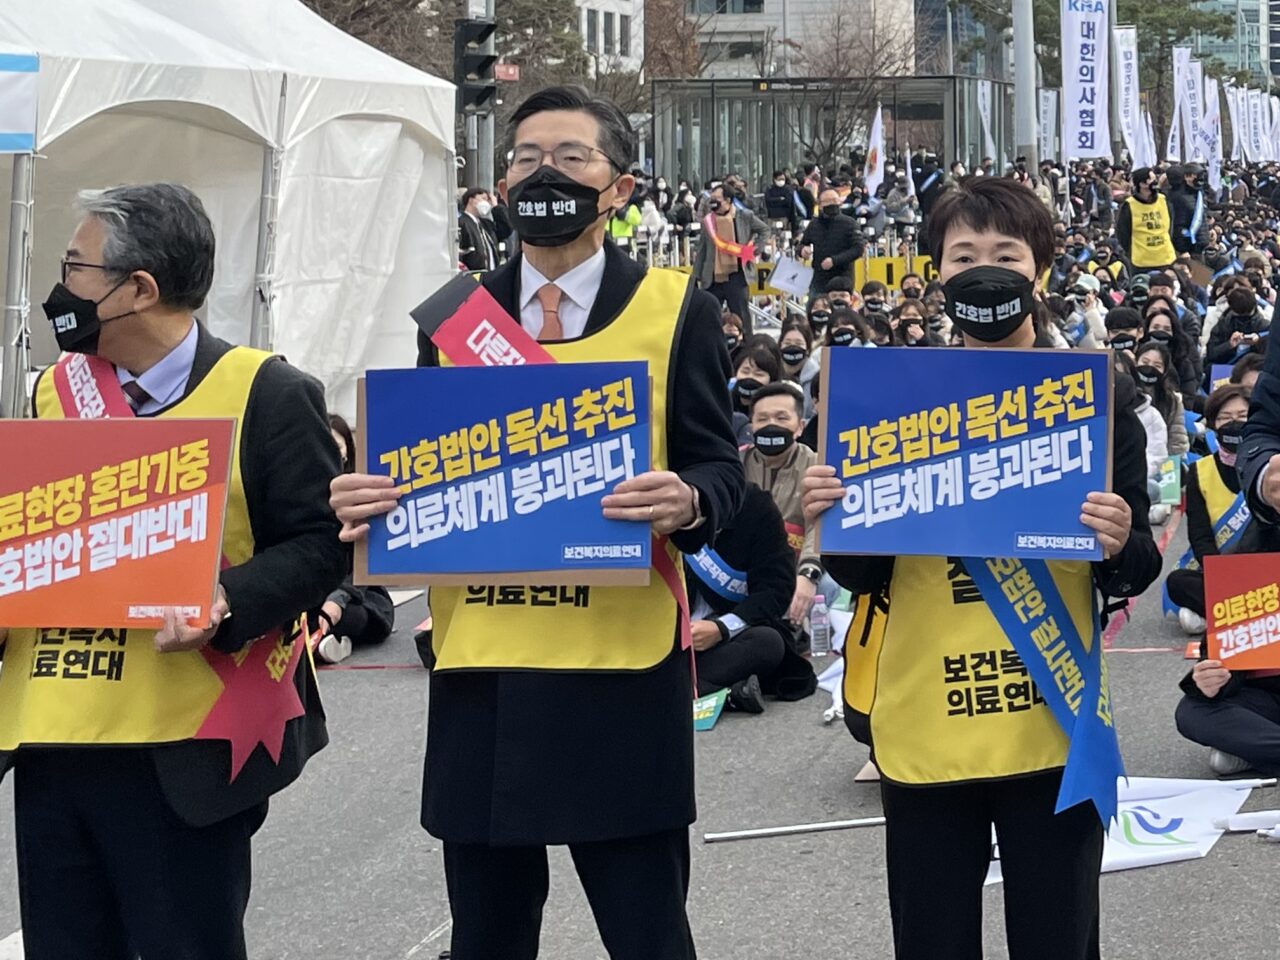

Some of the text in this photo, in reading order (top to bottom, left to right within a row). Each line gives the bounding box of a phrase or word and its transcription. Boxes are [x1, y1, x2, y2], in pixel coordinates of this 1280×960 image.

[1078, 20, 1096, 149] 대한의사협회
[518, 200, 576, 216] 간호법 반대
[955, 301, 994, 323] 간호법
[380, 377, 636, 494] 간호법안 독선 추진
[839, 368, 1096, 478] 간호법안 독선 추진
[88, 438, 210, 518] 혼란가중
[386, 433, 636, 551] 의료체계 붕괴된다
[841, 425, 1093, 529] 의료체계 붕괴된다
[88, 492, 209, 572] 절대반대
[564, 544, 642, 559] 보건복지의료연대
[1016, 534, 1095, 550] 보건복지의료연대
[1213, 582, 1280, 628] 의료현장
[31, 649, 124, 681] 료연대
[943, 648, 1029, 683] 보건복
